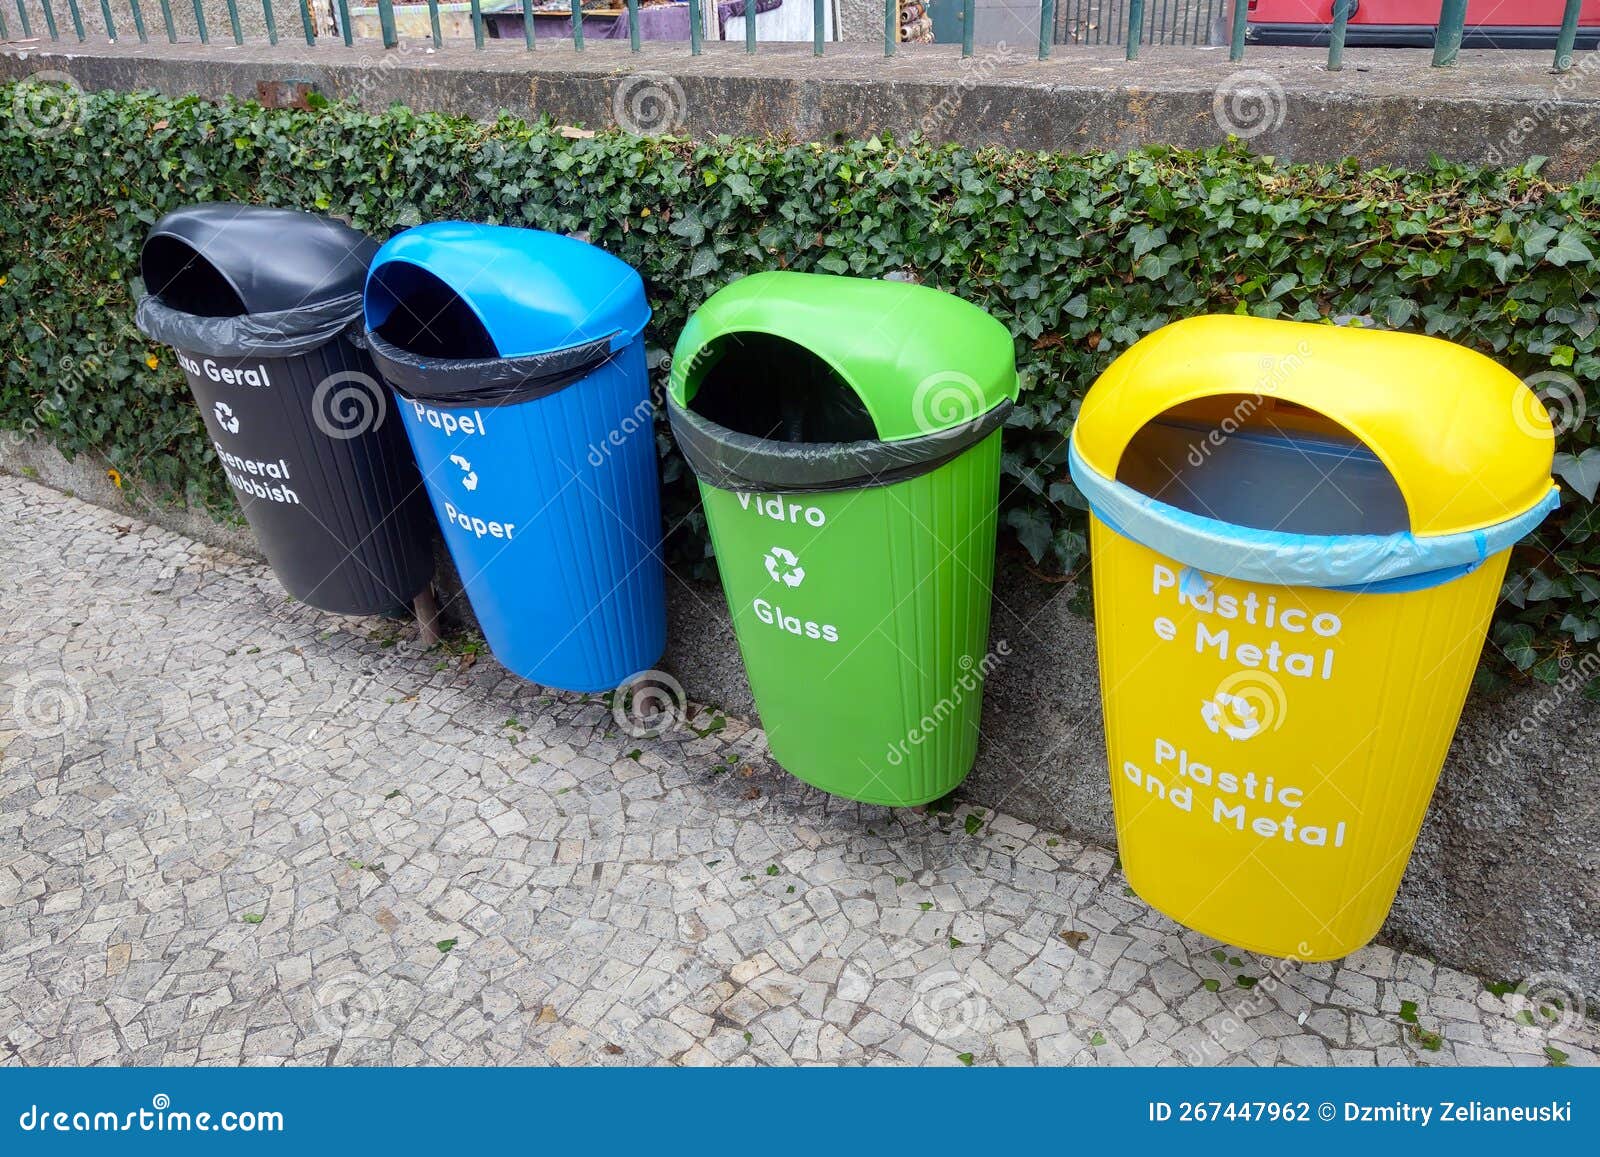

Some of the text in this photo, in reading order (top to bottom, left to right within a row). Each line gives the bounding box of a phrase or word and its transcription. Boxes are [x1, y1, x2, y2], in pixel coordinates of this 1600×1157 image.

[203, 358, 271, 387] Geral
[412, 401, 486, 437] Papel
[213, 441, 291, 480] General
[444, 502, 516, 540] Paper
[735, 491, 826, 527] Vidro
[753, 598, 839, 642] Glass
[1153, 616, 1335, 681] e Metal
[1155, 737, 1304, 809] Plastic
[1123, 760, 1347, 849] and Metal
